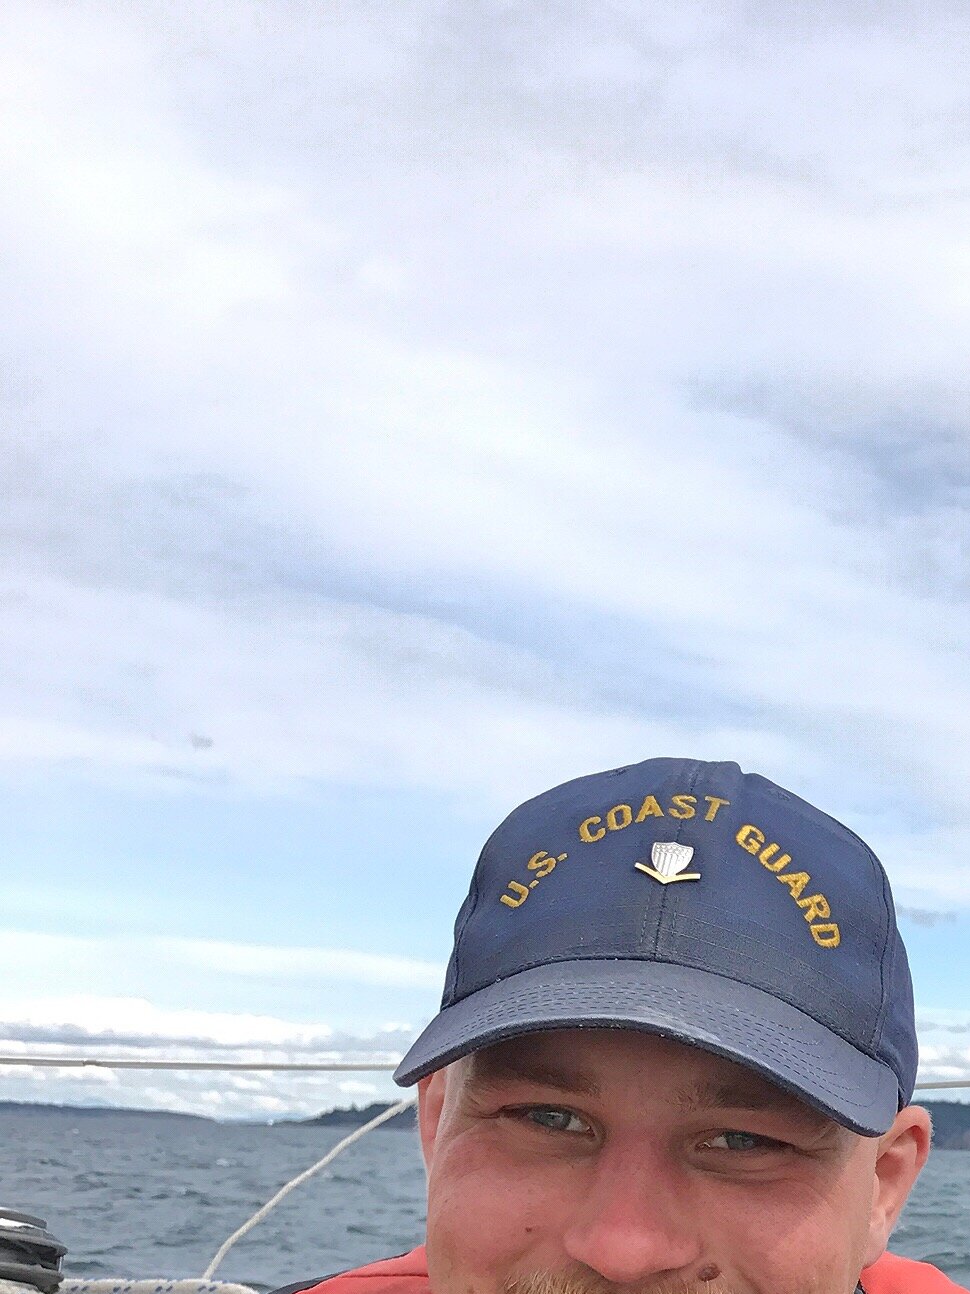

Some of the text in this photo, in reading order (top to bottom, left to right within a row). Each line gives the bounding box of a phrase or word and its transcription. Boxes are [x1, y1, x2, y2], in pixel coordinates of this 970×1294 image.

[500, 794, 842, 950] U.S. COAST GUARD
